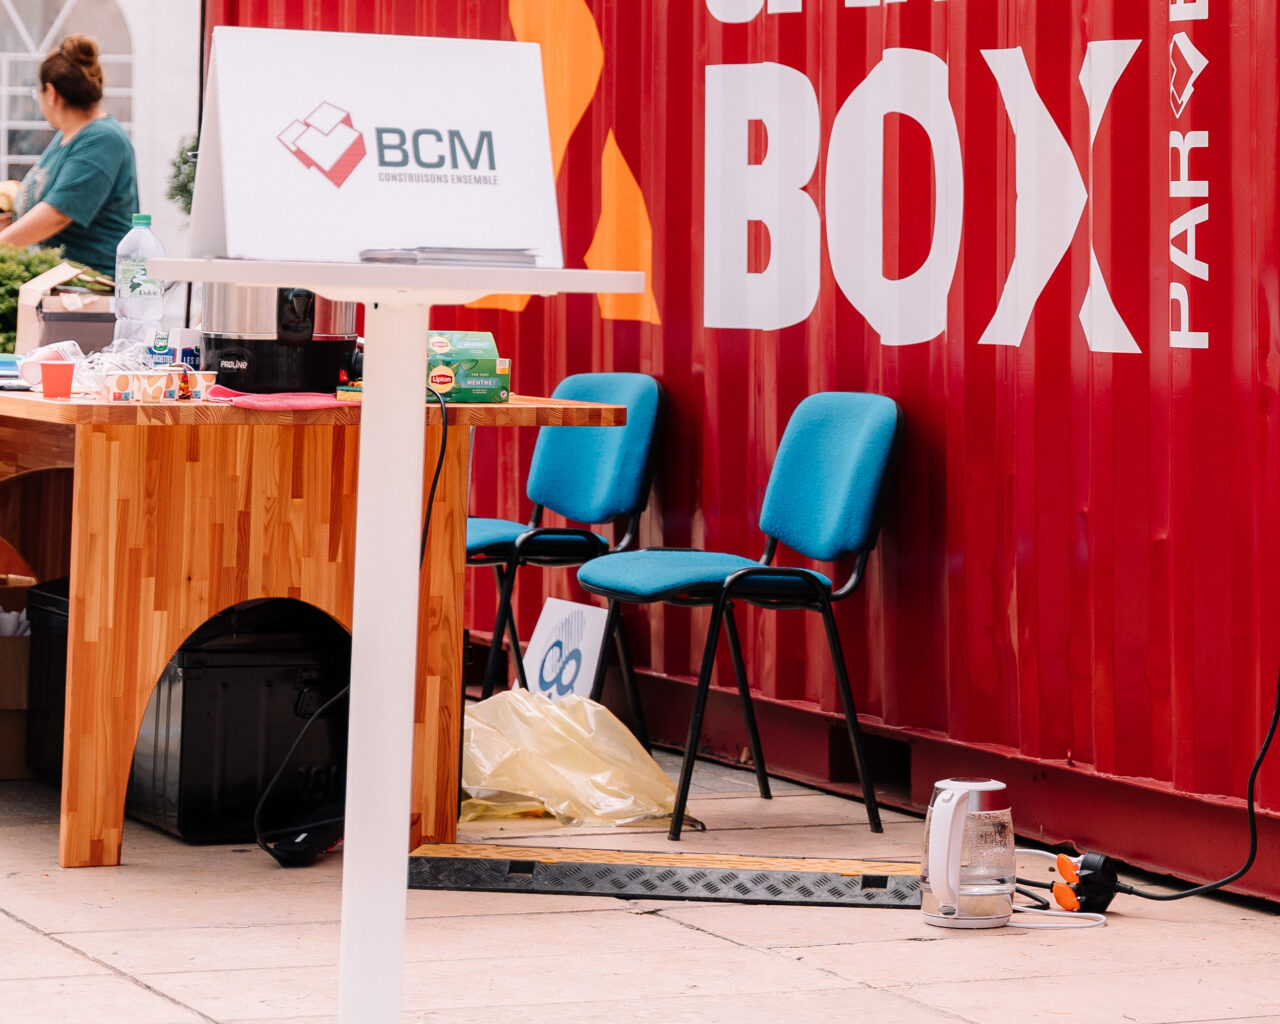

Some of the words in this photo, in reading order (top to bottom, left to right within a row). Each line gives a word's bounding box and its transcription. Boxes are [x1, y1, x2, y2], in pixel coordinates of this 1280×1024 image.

[375, 126, 496, 171] BCM
[378, 172, 449, 184] CONSTRUISONS
[451, 174, 499, 186] ENSEMBLE
[703, 39, 1143, 354] BOX
[1169, 130, 1209, 349] PAR
